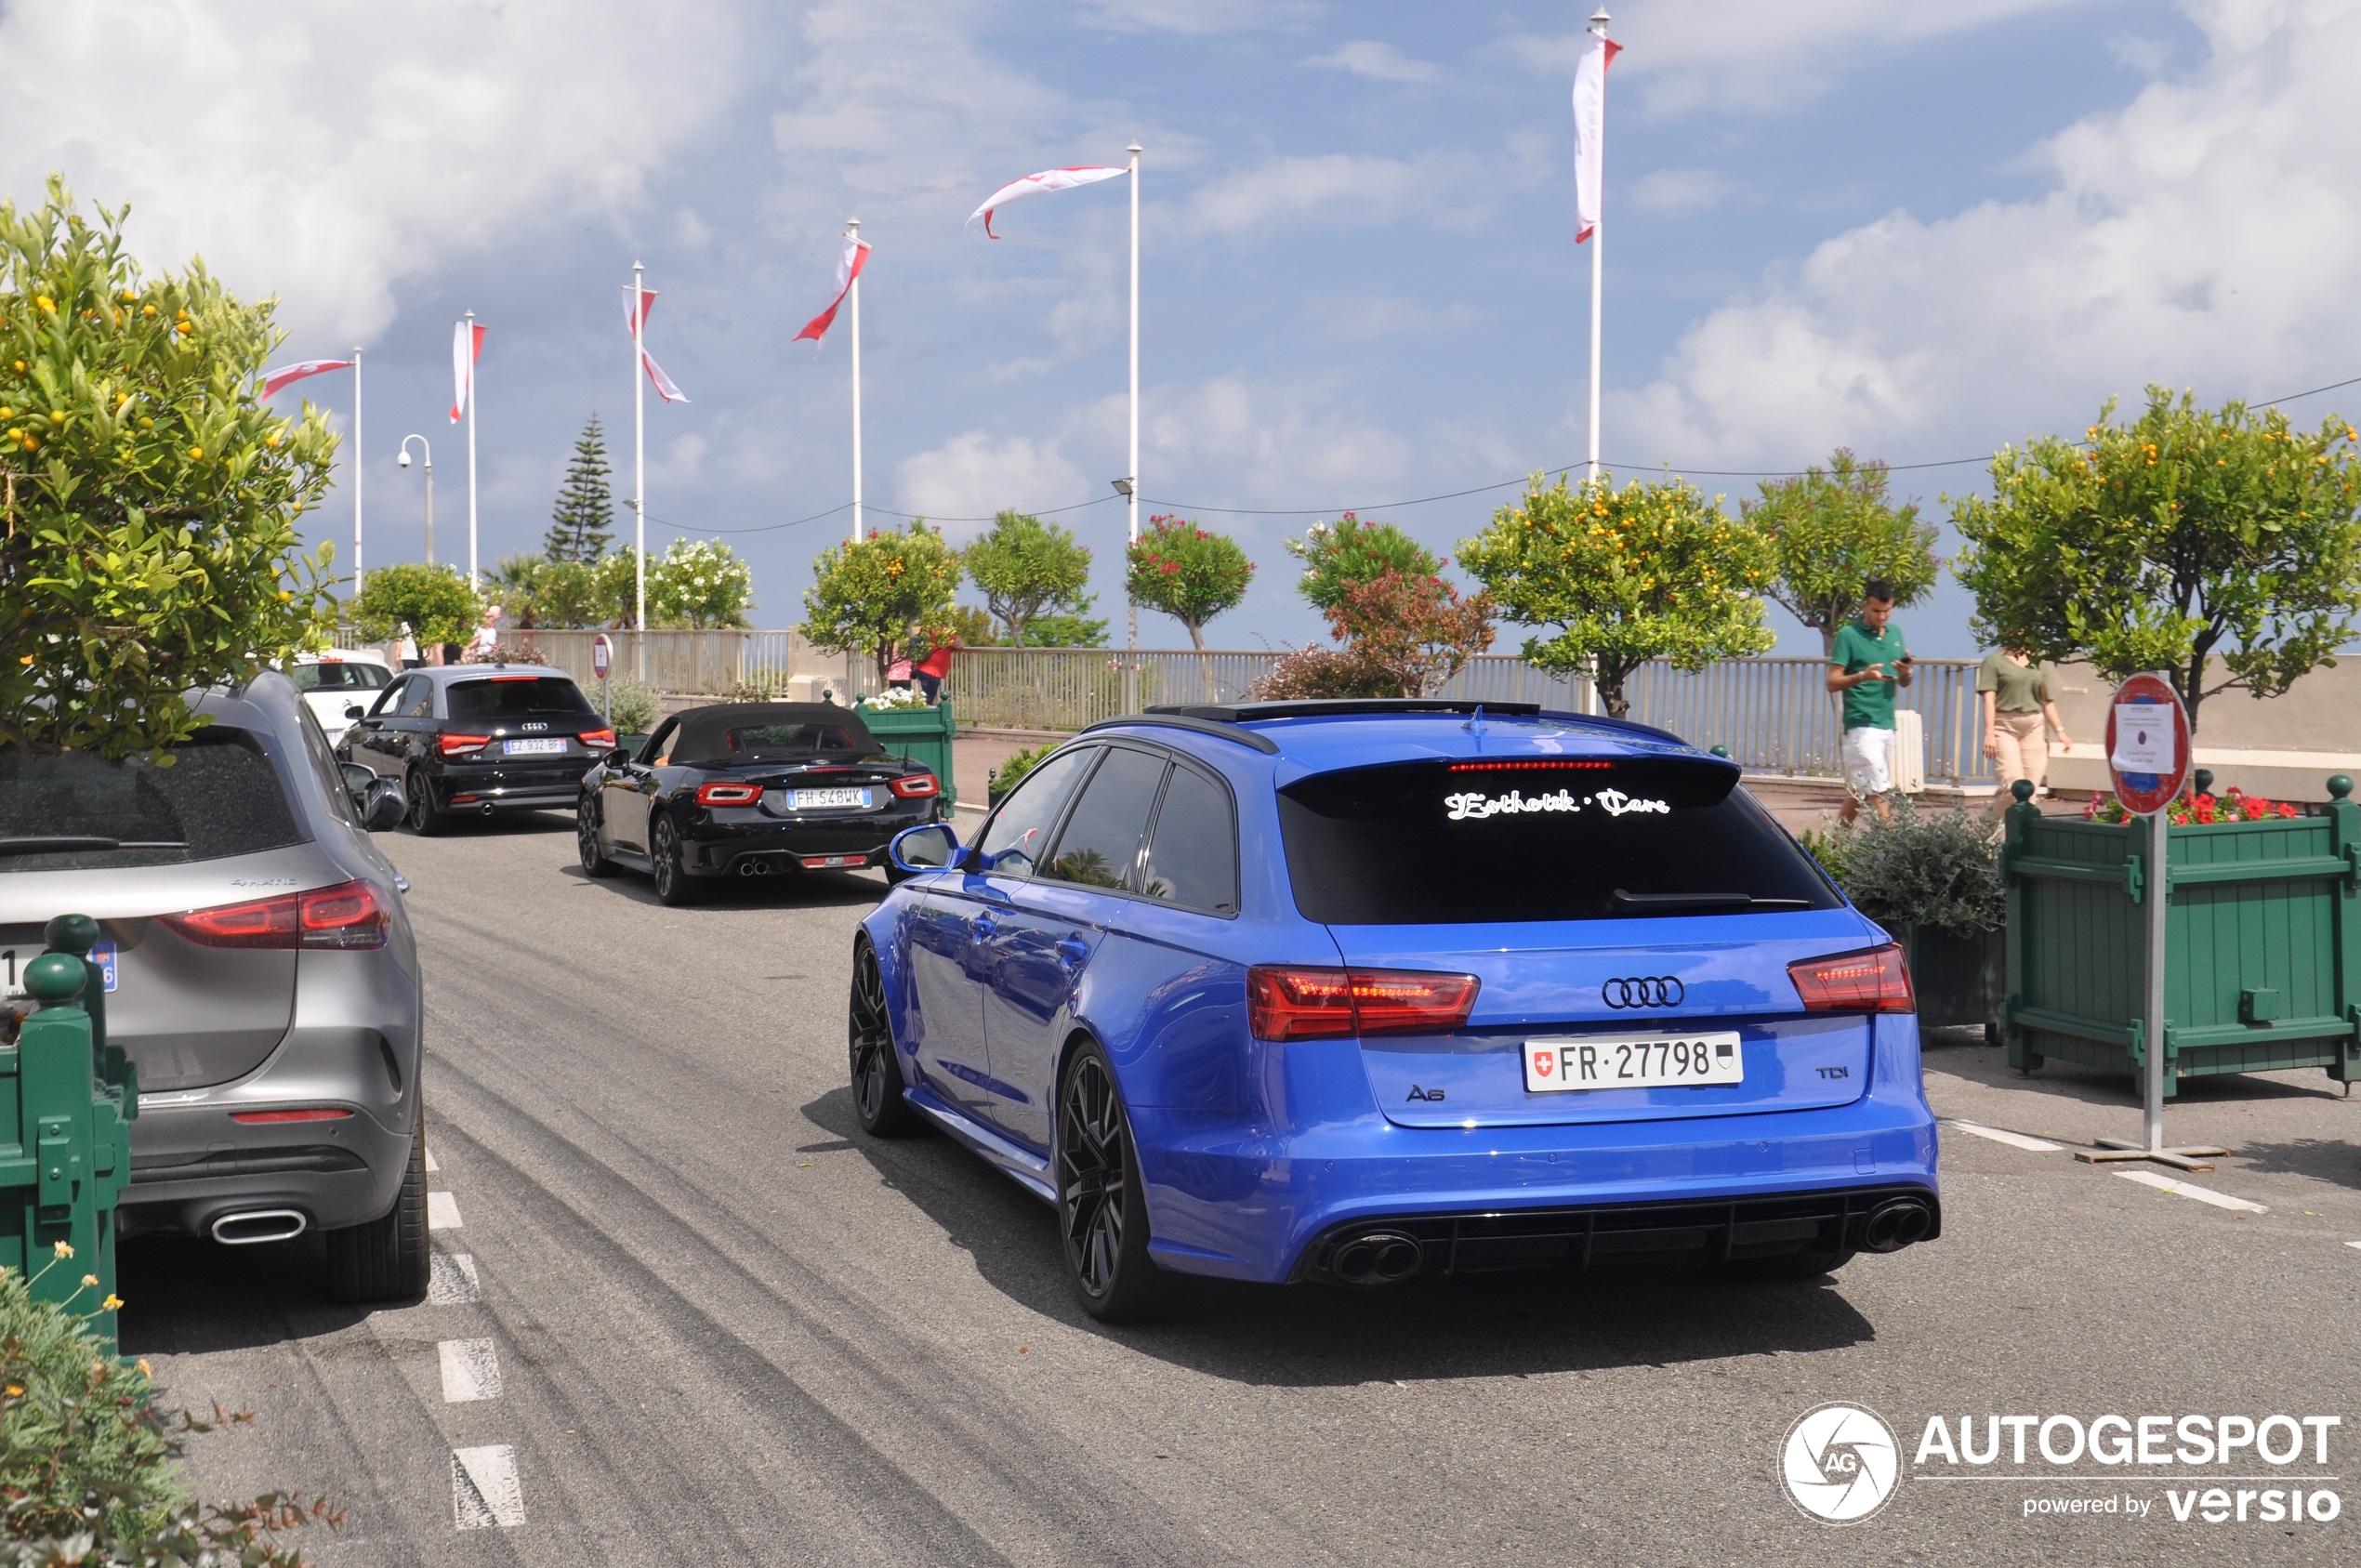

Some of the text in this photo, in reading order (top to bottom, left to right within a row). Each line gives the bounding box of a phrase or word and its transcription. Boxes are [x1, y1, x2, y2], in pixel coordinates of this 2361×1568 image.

[796, 789, 862, 805] FH 548WK
[1595, 791, 1670, 816] Cars
[1815, 1066, 1849, 1079] TDI
[1405, 1084, 1445, 1102] A6
